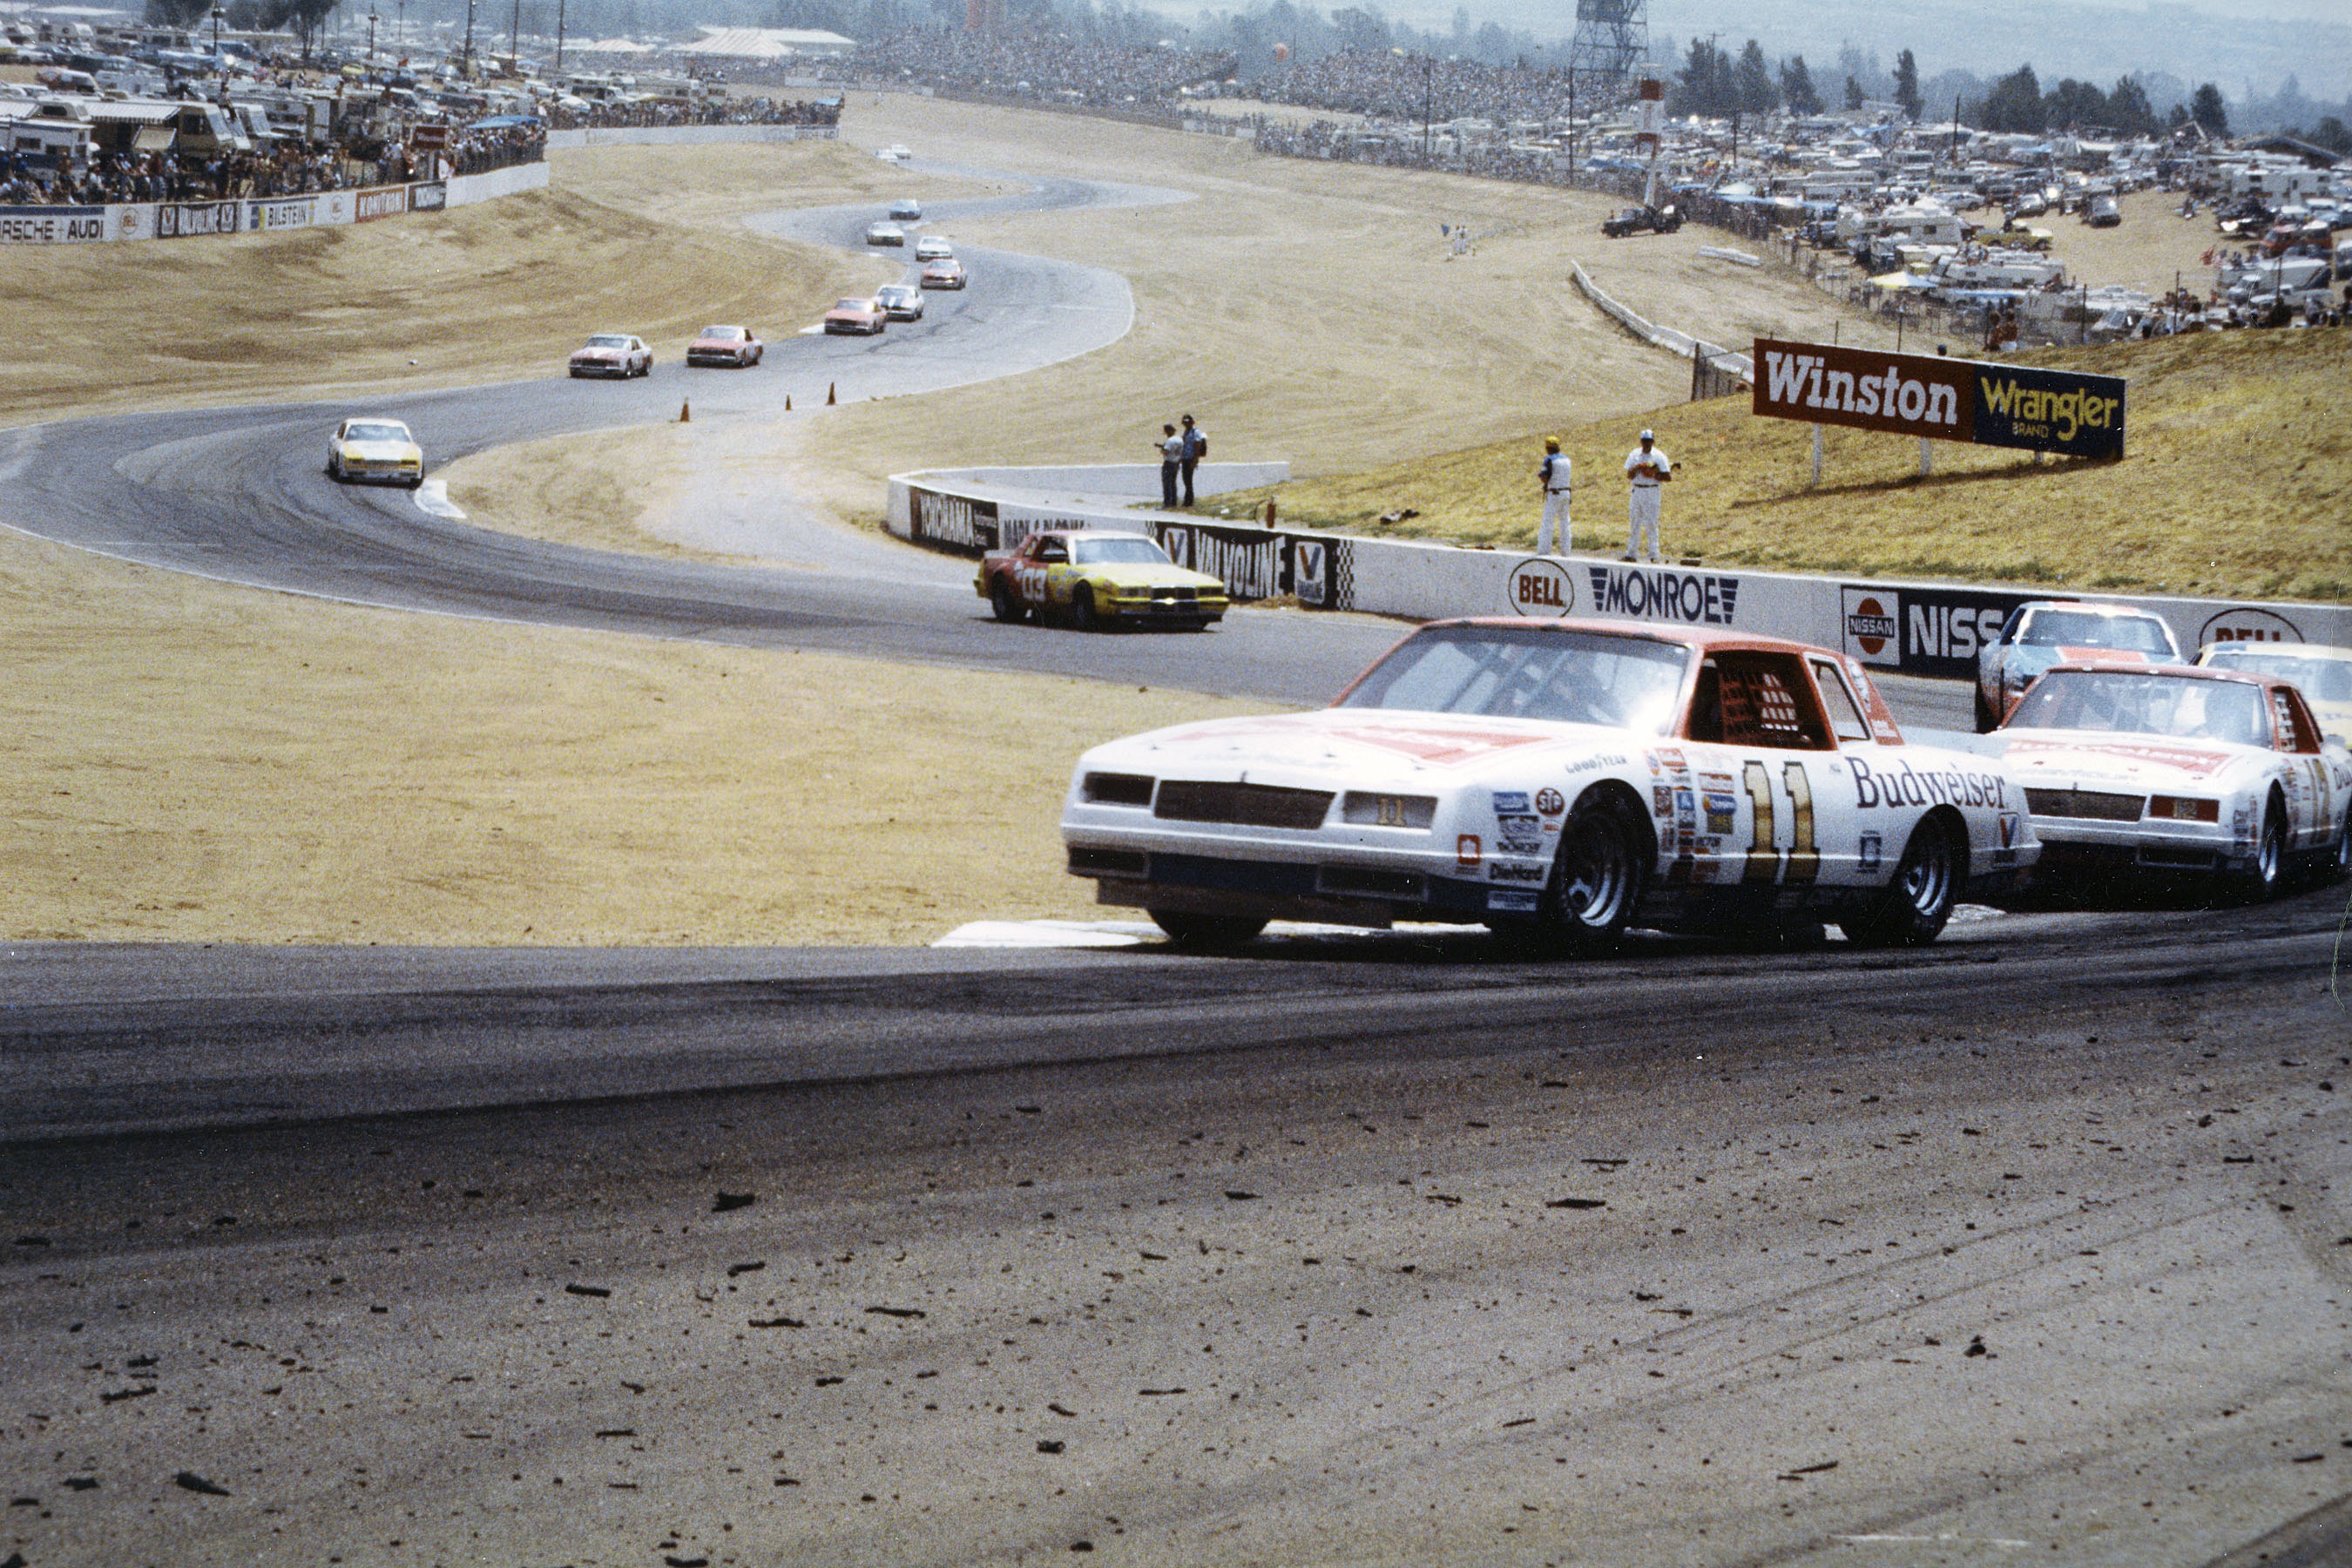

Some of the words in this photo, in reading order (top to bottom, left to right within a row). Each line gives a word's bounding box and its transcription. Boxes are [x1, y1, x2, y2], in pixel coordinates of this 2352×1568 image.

[0, 220, 54, 240] RSCHE
[67, 220, 104, 240] AUDI
[268, 203, 306, 226] BILSTEIN
[1766, 351, 1957, 425] Winston
[1981, 377, 2119, 442] Wrangler
[2012, 422, 2049, 439] BRAND
[1195, 528, 1286, 598] VALVOLINE
[1519, 574, 1565, 607] BELL
[1605, 569, 1722, 624] MONROE
[1849, 618, 1894, 637] NISSAN
[1909, 605, 2004, 659] NISS
[1538, 790, 1564, 813] STP
[1845, 756, 2005, 808] Budweiser
[1377, 797, 1407, 827] 11
[1743, 760, 1821, 884] 11
